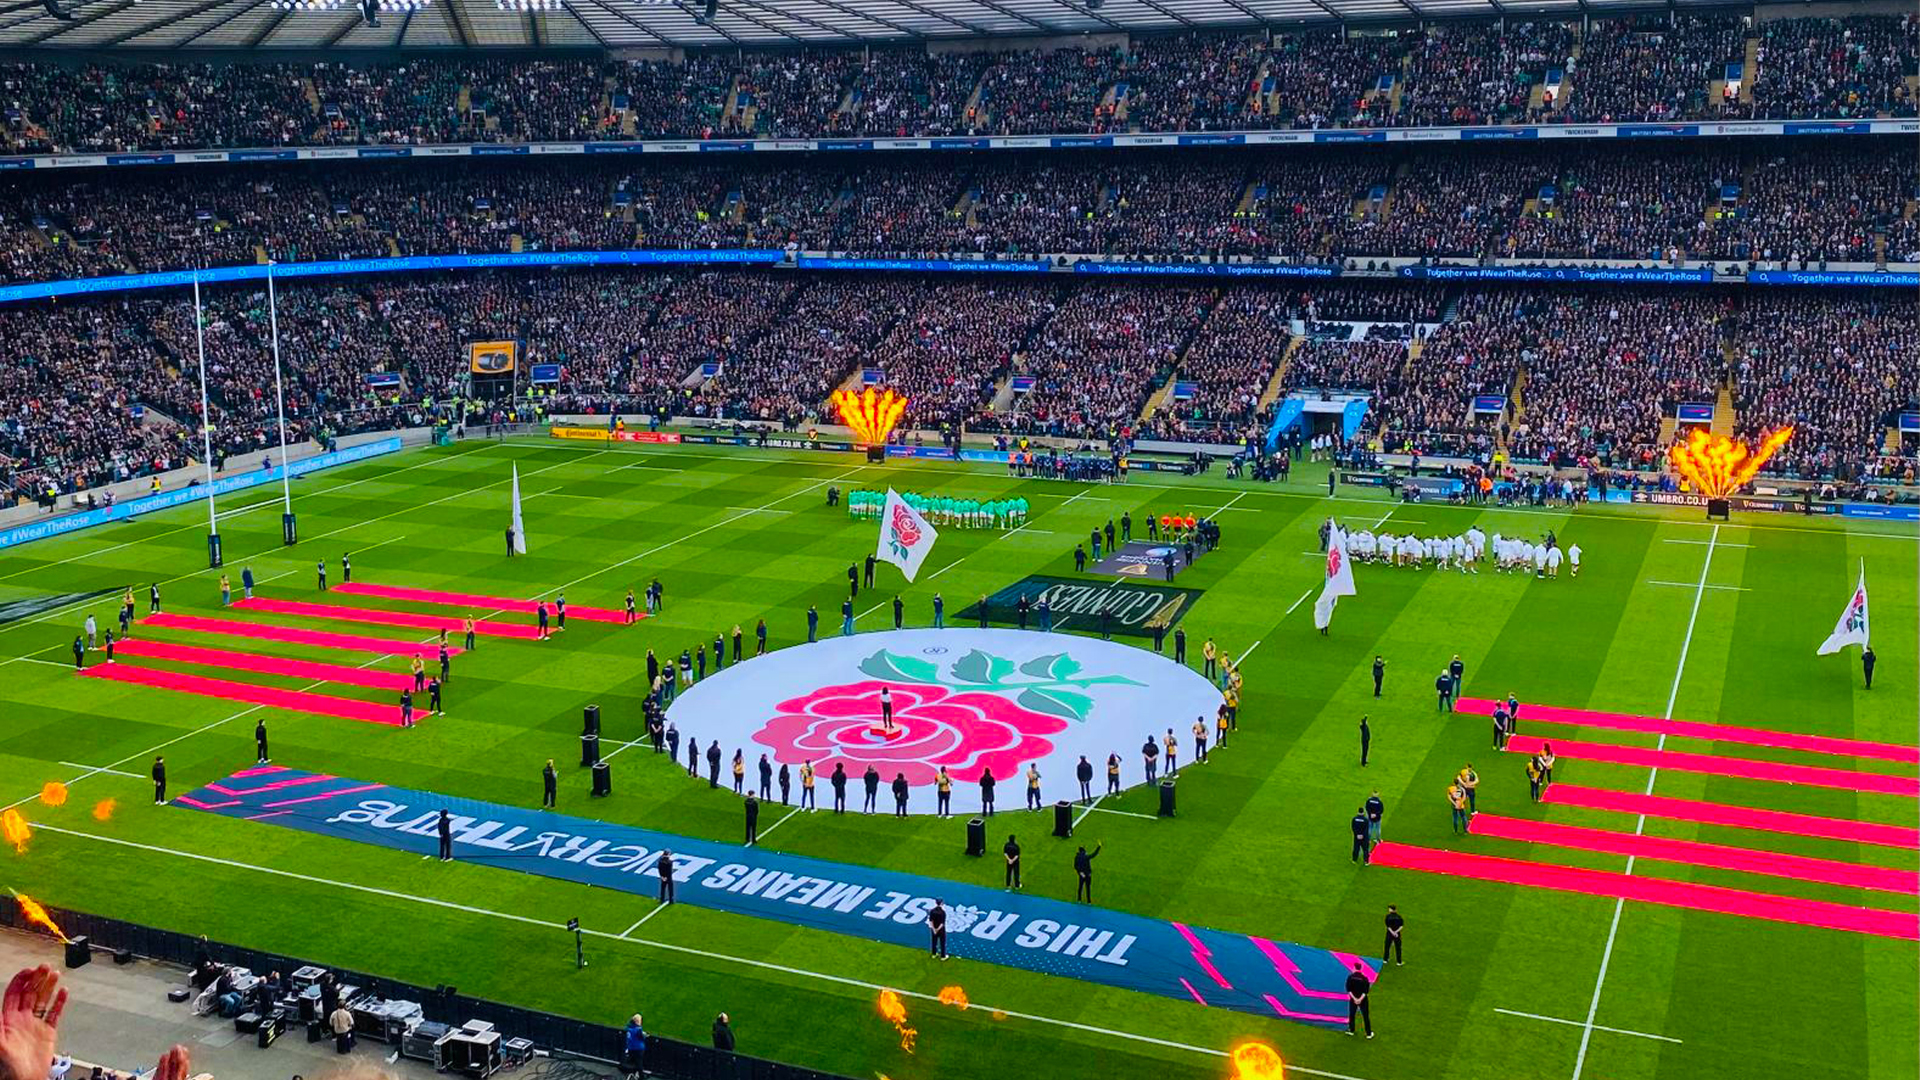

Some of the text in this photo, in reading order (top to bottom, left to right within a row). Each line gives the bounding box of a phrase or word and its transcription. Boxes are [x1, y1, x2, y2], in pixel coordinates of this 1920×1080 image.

[466, 253, 600, 267] Together we #WearTheRose
[651, 252, 692, 263] Together
[692, 253, 708, 261] we
[271, 264, 317, 276] Together
[319, 264, 335, 272] we
[1098, 264, 1130, 274] Together
[1227, 267, 1261, 277] Together
[1426, 269, 1462, 279] Together
[1579, 271, 1619, 281] Together
[1636, 271, 1701, 280] #WearTheRose
[1791, 274, 1833, 284] Together
[76, 279, 123, 292] Together
[125, 278, 139, 286] we
[128, 496, 171, 514] Together
[174, 492, 187, 502] we
[12, 515, 90, 542] #WearTheRose
[702, 863, 877, 914] MEANS
[862, 891, 1020, 941] RSE
[1015, 919, 1138, 966] THIS
